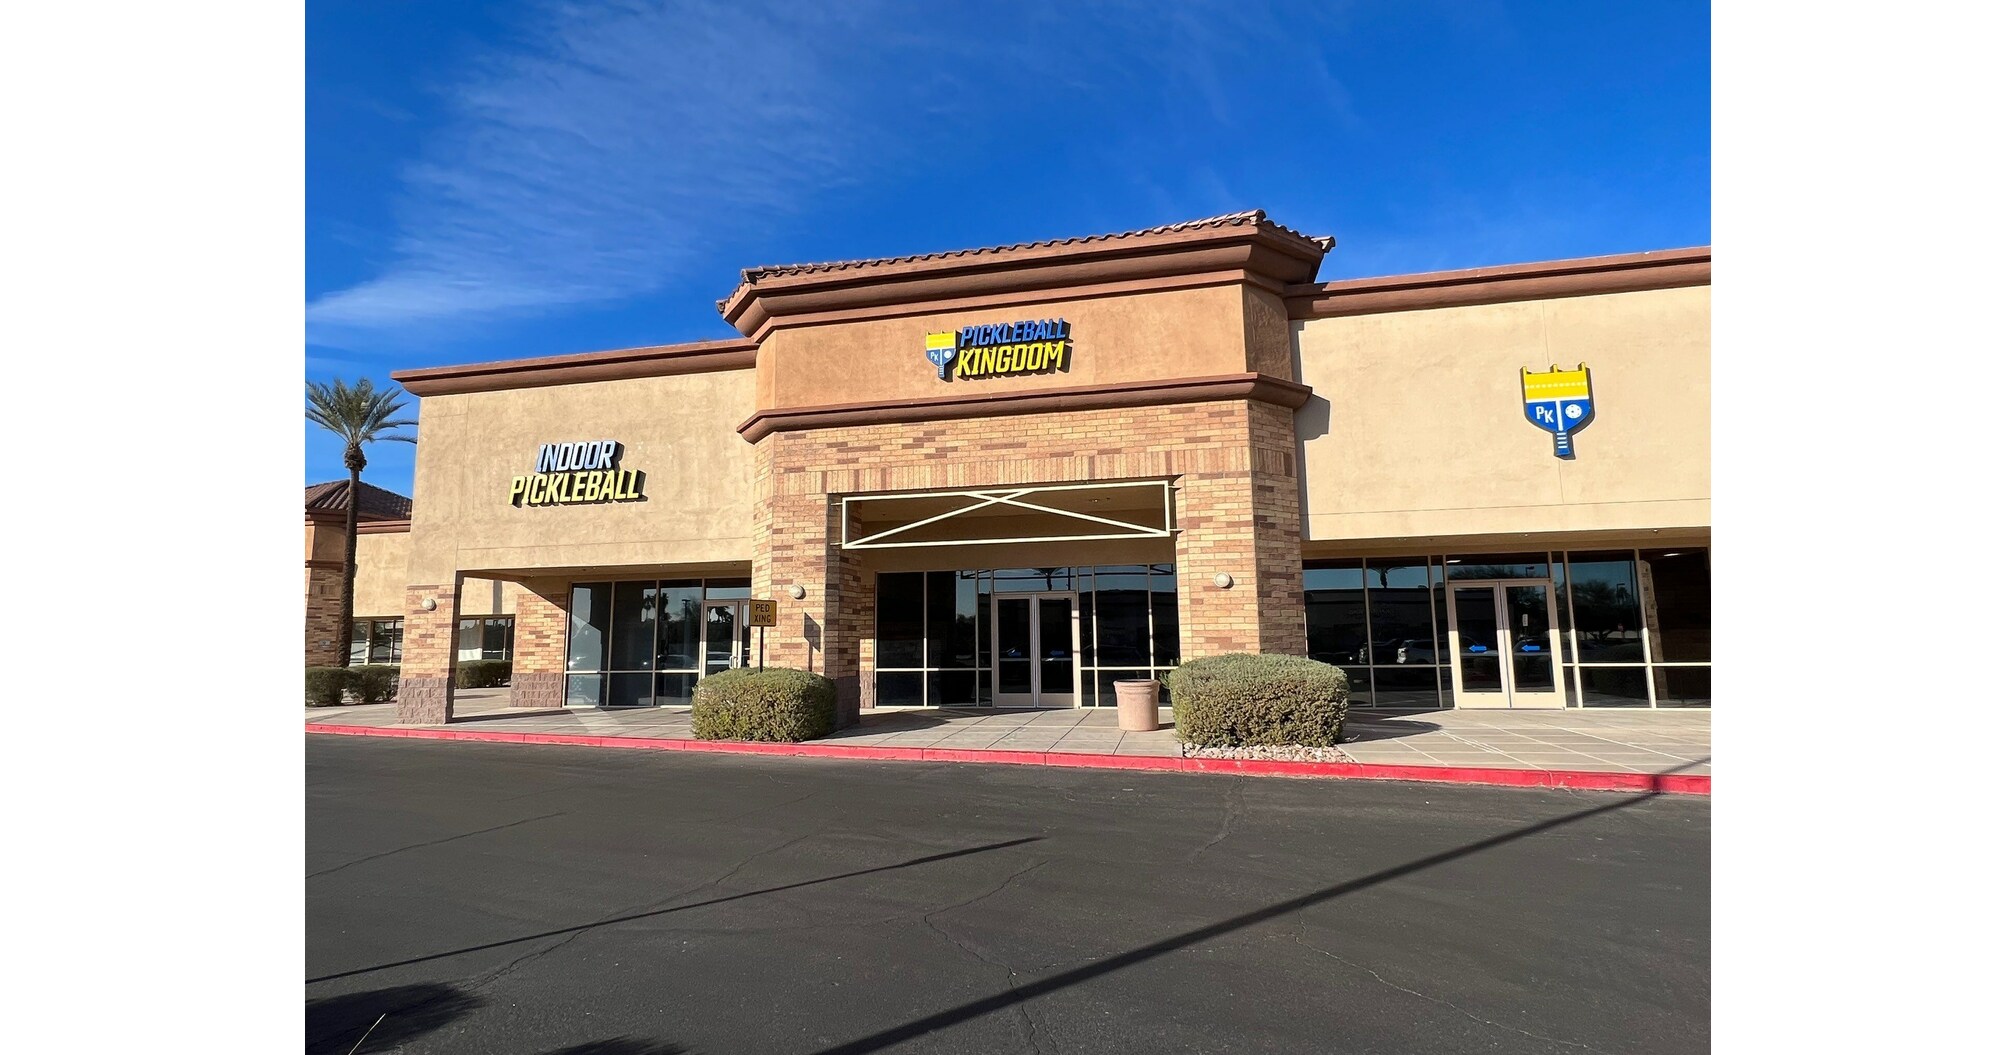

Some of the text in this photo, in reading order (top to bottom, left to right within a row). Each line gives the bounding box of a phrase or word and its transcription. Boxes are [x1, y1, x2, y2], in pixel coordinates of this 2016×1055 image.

[960, 318, 1067, 347] PICKLEBALL
[956, 340, 1065, 376] KINGDOM
[1535, 405, 1555, 424] PK
[535, 440, 616, 473] INDOOR
[508, 469, 640, 505] PICKLEBALL
[754, 614, 772, 623] XING
[755, 603, 770, 613] PED
